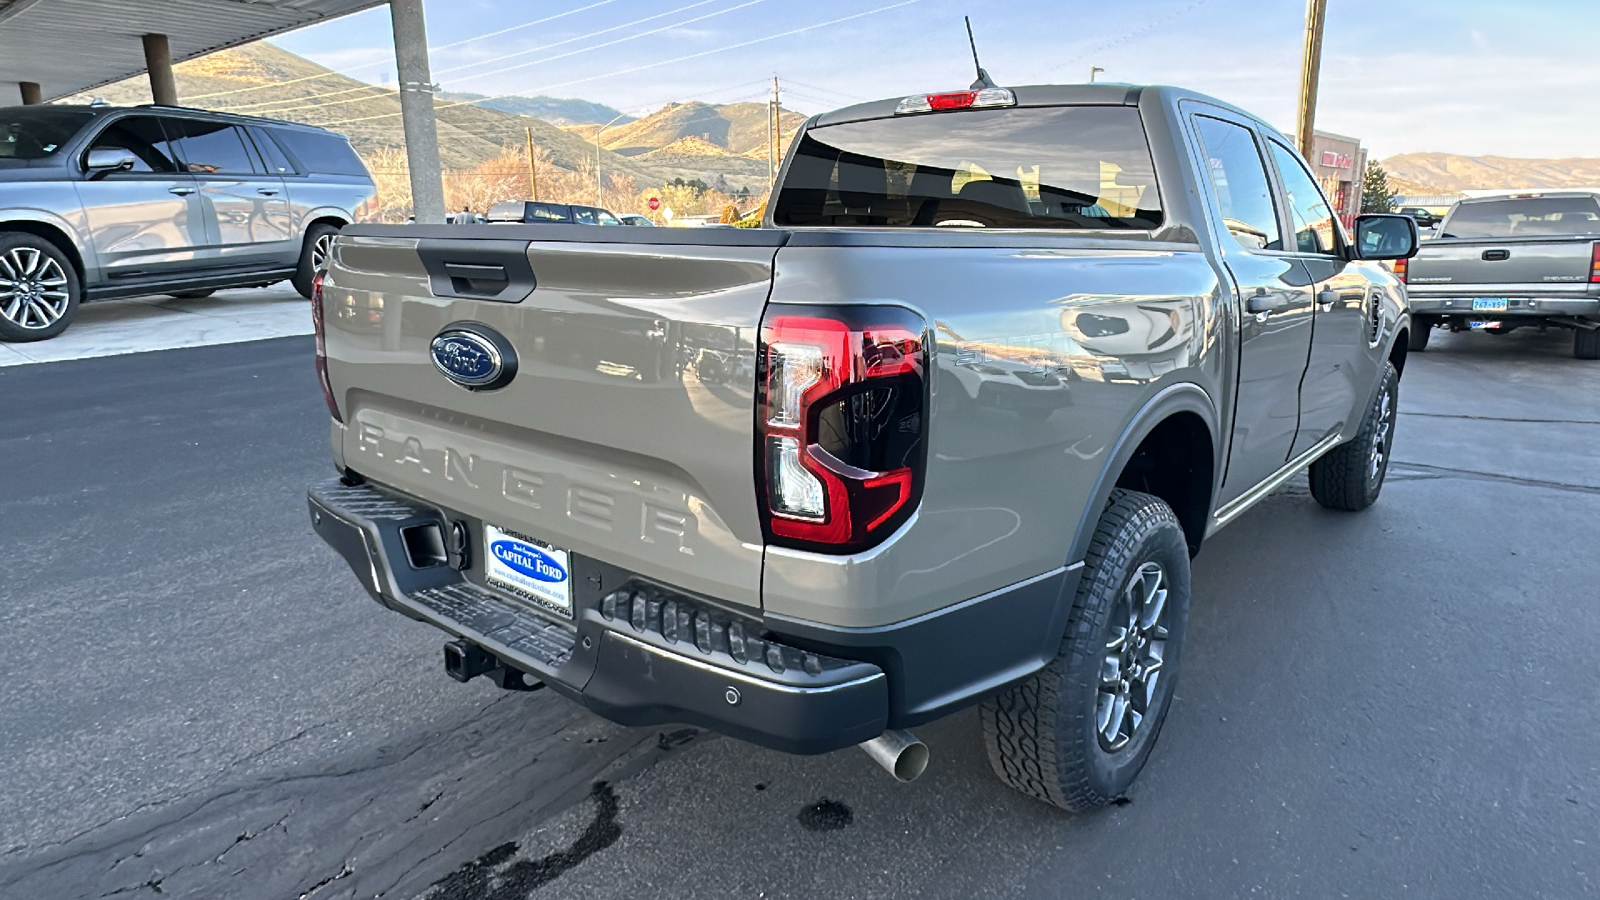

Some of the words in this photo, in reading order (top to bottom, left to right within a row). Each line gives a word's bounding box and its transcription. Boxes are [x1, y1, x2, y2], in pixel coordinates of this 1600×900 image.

[443, 341, 485, 373] Ford
[357, 420, 695, 556] RANGER
[494, 544, 534, 570] CAPITAL
[536, 559, 563, 581] FORD
